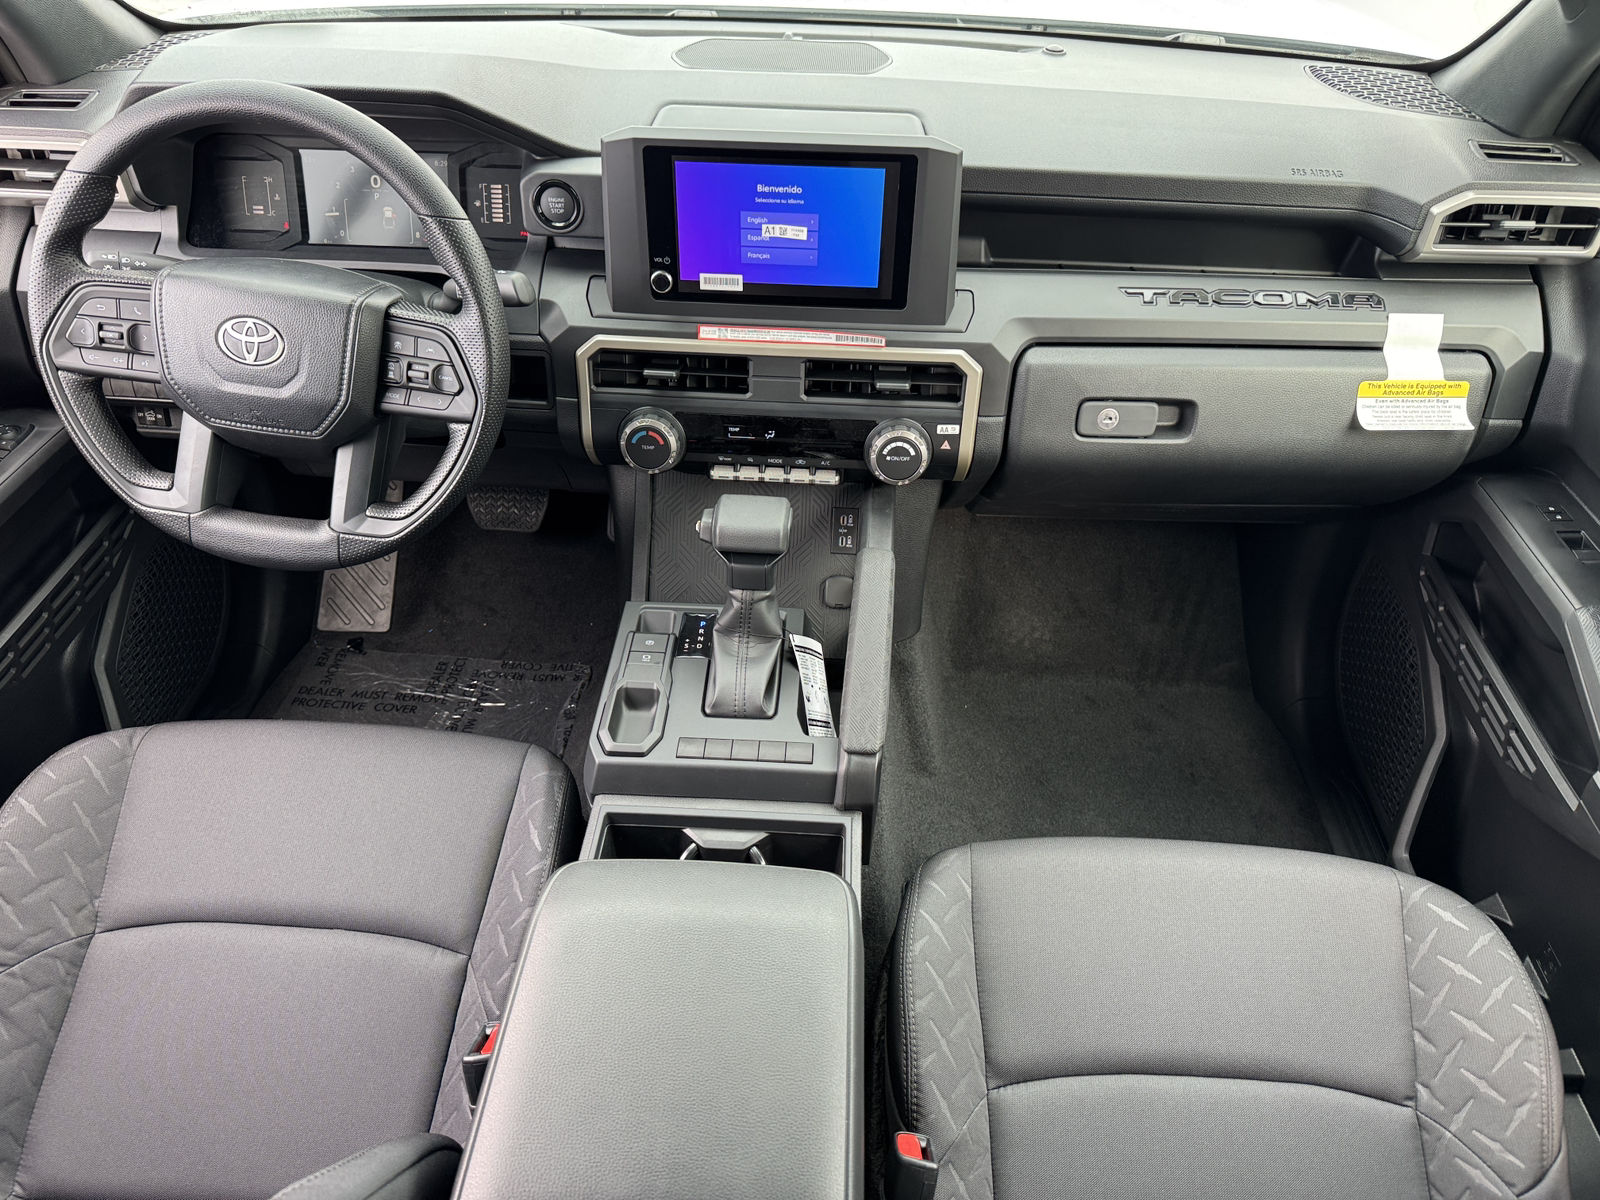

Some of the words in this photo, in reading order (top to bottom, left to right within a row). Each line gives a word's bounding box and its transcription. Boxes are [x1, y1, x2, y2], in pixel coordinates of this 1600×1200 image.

[1291, 168, 1307, 176] SRS
[1310, 168, 1344, 178] AIRBAG
[370, 175, 381, 188] 0
[757, 184, 802, 194] Bienvenido
[764, 226, 775, 236] A1
[1118, 286, 1386, 312] TACOMA
[500, 660, 542, 671] COVER
[471, 669, 524, 681] REMOVE
[531, 673, 566, 682] MUST
[298, 685, 345, 697] DEALER
[352, 690, 388, 700] MUST
[394, 692, 448, 705] REMOVE
[291, 697, 368, 711] PROTECTIVE
[374, 702, 418, 714] COVER
